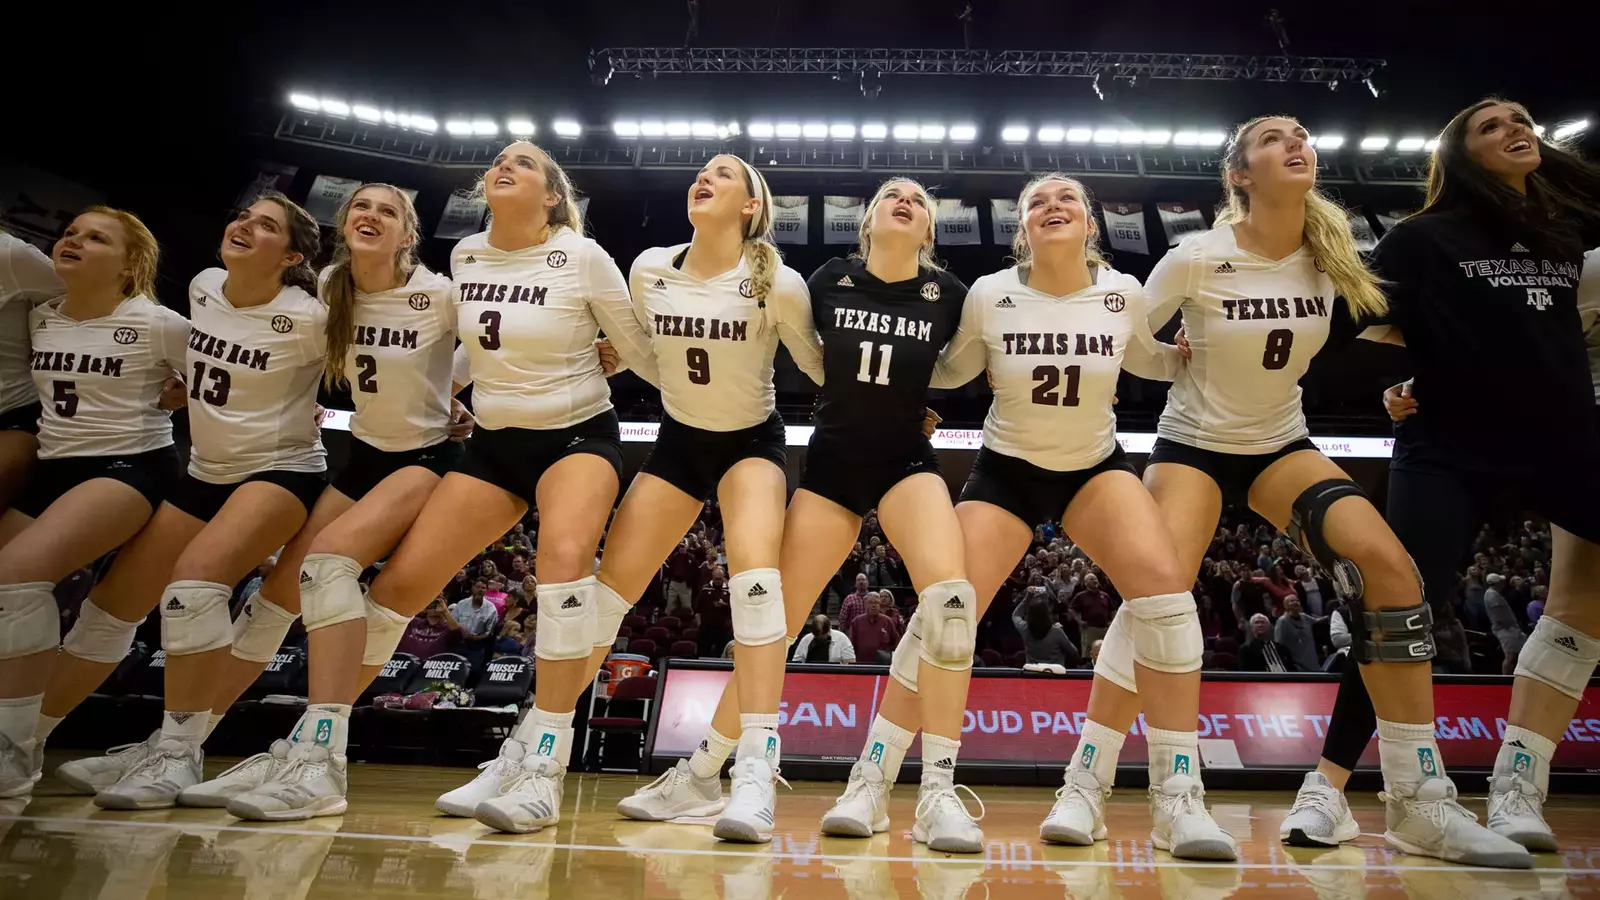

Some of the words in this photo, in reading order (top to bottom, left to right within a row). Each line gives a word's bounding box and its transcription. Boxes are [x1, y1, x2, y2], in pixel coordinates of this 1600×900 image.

[548, 251, 567, 267] SEC
[1460, 259, 1538, 278] TEXAS
[1542, 260, 1579, 280] A&M
[922, 283, 940, 300] SEC
[1488, 275, 1573, 288] VOLLEYBALL
[410, 294, 429, 310] SEC
[460, 283, 508, 303] TEXAS
[508, 286, 548, 306] A&M
[1105, 294, 1124, 311] SEC
[1222, 297, 1290, 320] TEXAS
[1293, 296, 1328, 318] A&M
[272, 315, 293, 333] SEC
[478, 310, 502, 351] 3
[654, 314, 705, 338] TEXAS
[709, 318, 748, 342] A&M
[834, 307, 892, 334] TEXAS
[894, 316, 932, 342] A&M
[115, 328, 138, 344] SEC
[379, 327, 419, 350] A&M
[1003, 332, 1068, 355] TEXAS
[1075, 333, 1114, 357] A&M
[225, 343, 271, 371] A&M
[1262, 328, 1294, 371] 8
[77, 354, 124, 377] A&M
[355, 354, 378, 394] 2
[686, 347, 711, 386] 9
[856, 340, 893, 386] 11
[190, 360, 231, 408] 13
[1032, 364, 1081, 407] 21
[52, 380, 79, 418] 5
[938, 430, 983, 439] AGGIELA
[273, 654, 297, 663] SCLE
[423, 659, 462, 671] MUSCLE
[487, 662, 525, 673] MUSCLE
[425, 668, 451, 679] MILK
[489, 671, 515, 682] MILK
[621, 666, 633, 678] G
[961, 709, 1023, 734] OUD
[1234, 714, 1304, 738] THE
[1434, 716, 1493, 740] &M
